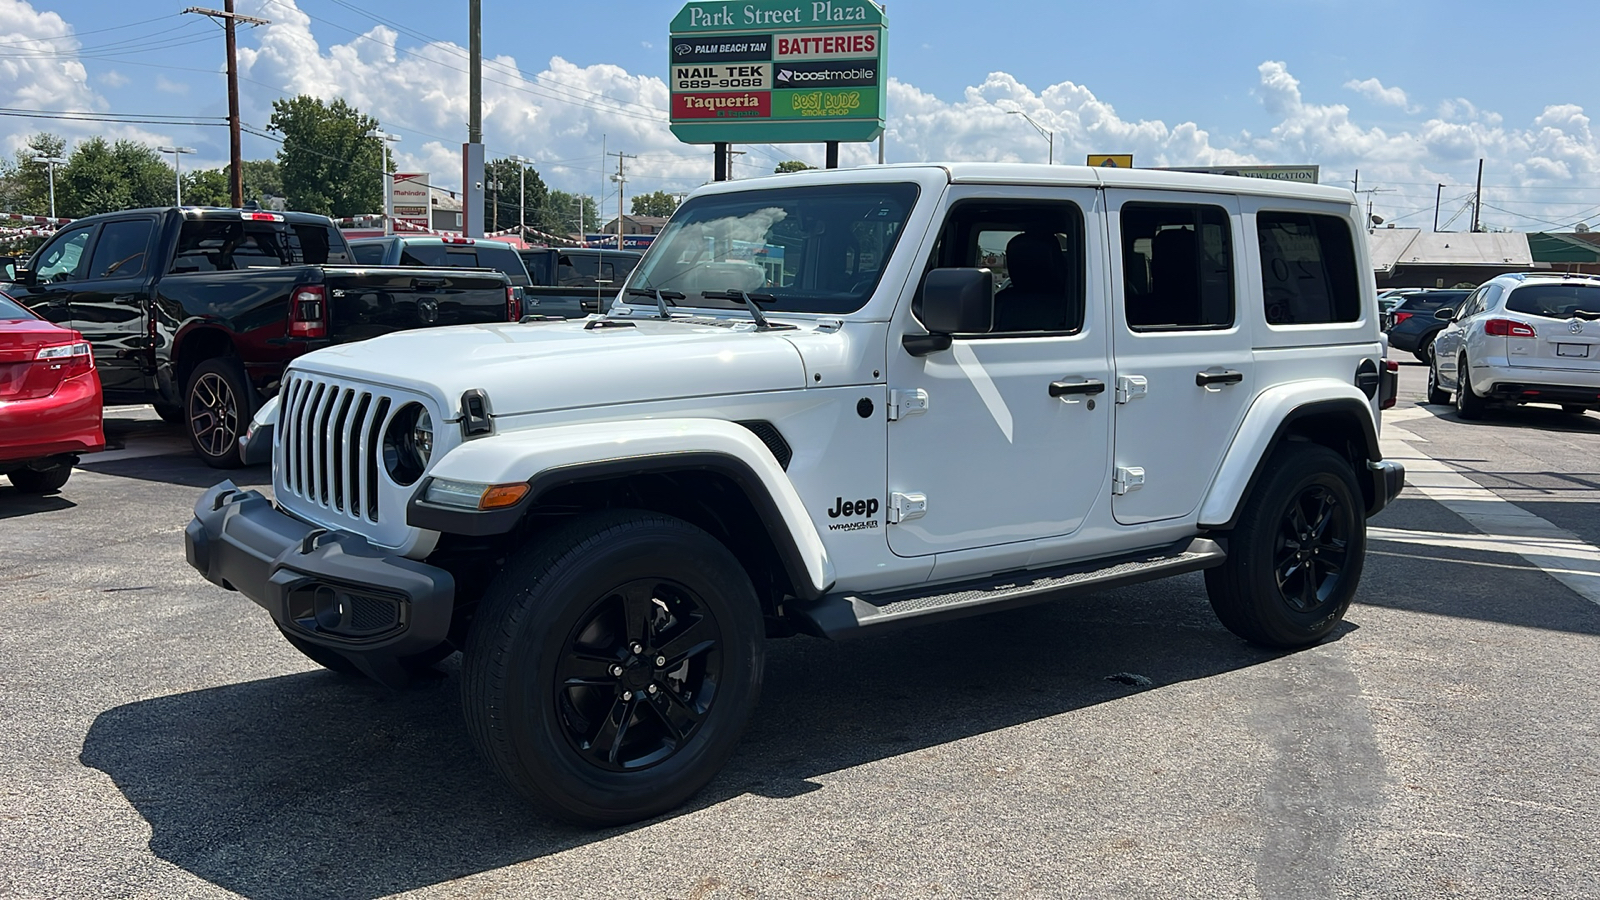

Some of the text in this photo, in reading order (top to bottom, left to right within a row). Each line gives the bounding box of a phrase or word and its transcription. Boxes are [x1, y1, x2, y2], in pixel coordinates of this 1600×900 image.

[690, 1, 867, 27] Park Street Plaza
[694, 42, 767, 54] PALM BEACH TAN
[778, 34, 876, 55] BATTERIES
[677, 65, 764, 79] NAIL TEK
[793, 68, 874, 81] boostmobile
[679, 78, 762, 89] 689-9088
[828, 108, 849, 116] SHOP
[1265, 171, 1312, 180] LOCATION
[827, 496, 879, 518] Jeep
[828, 520, 878, 531] WRANGLER
